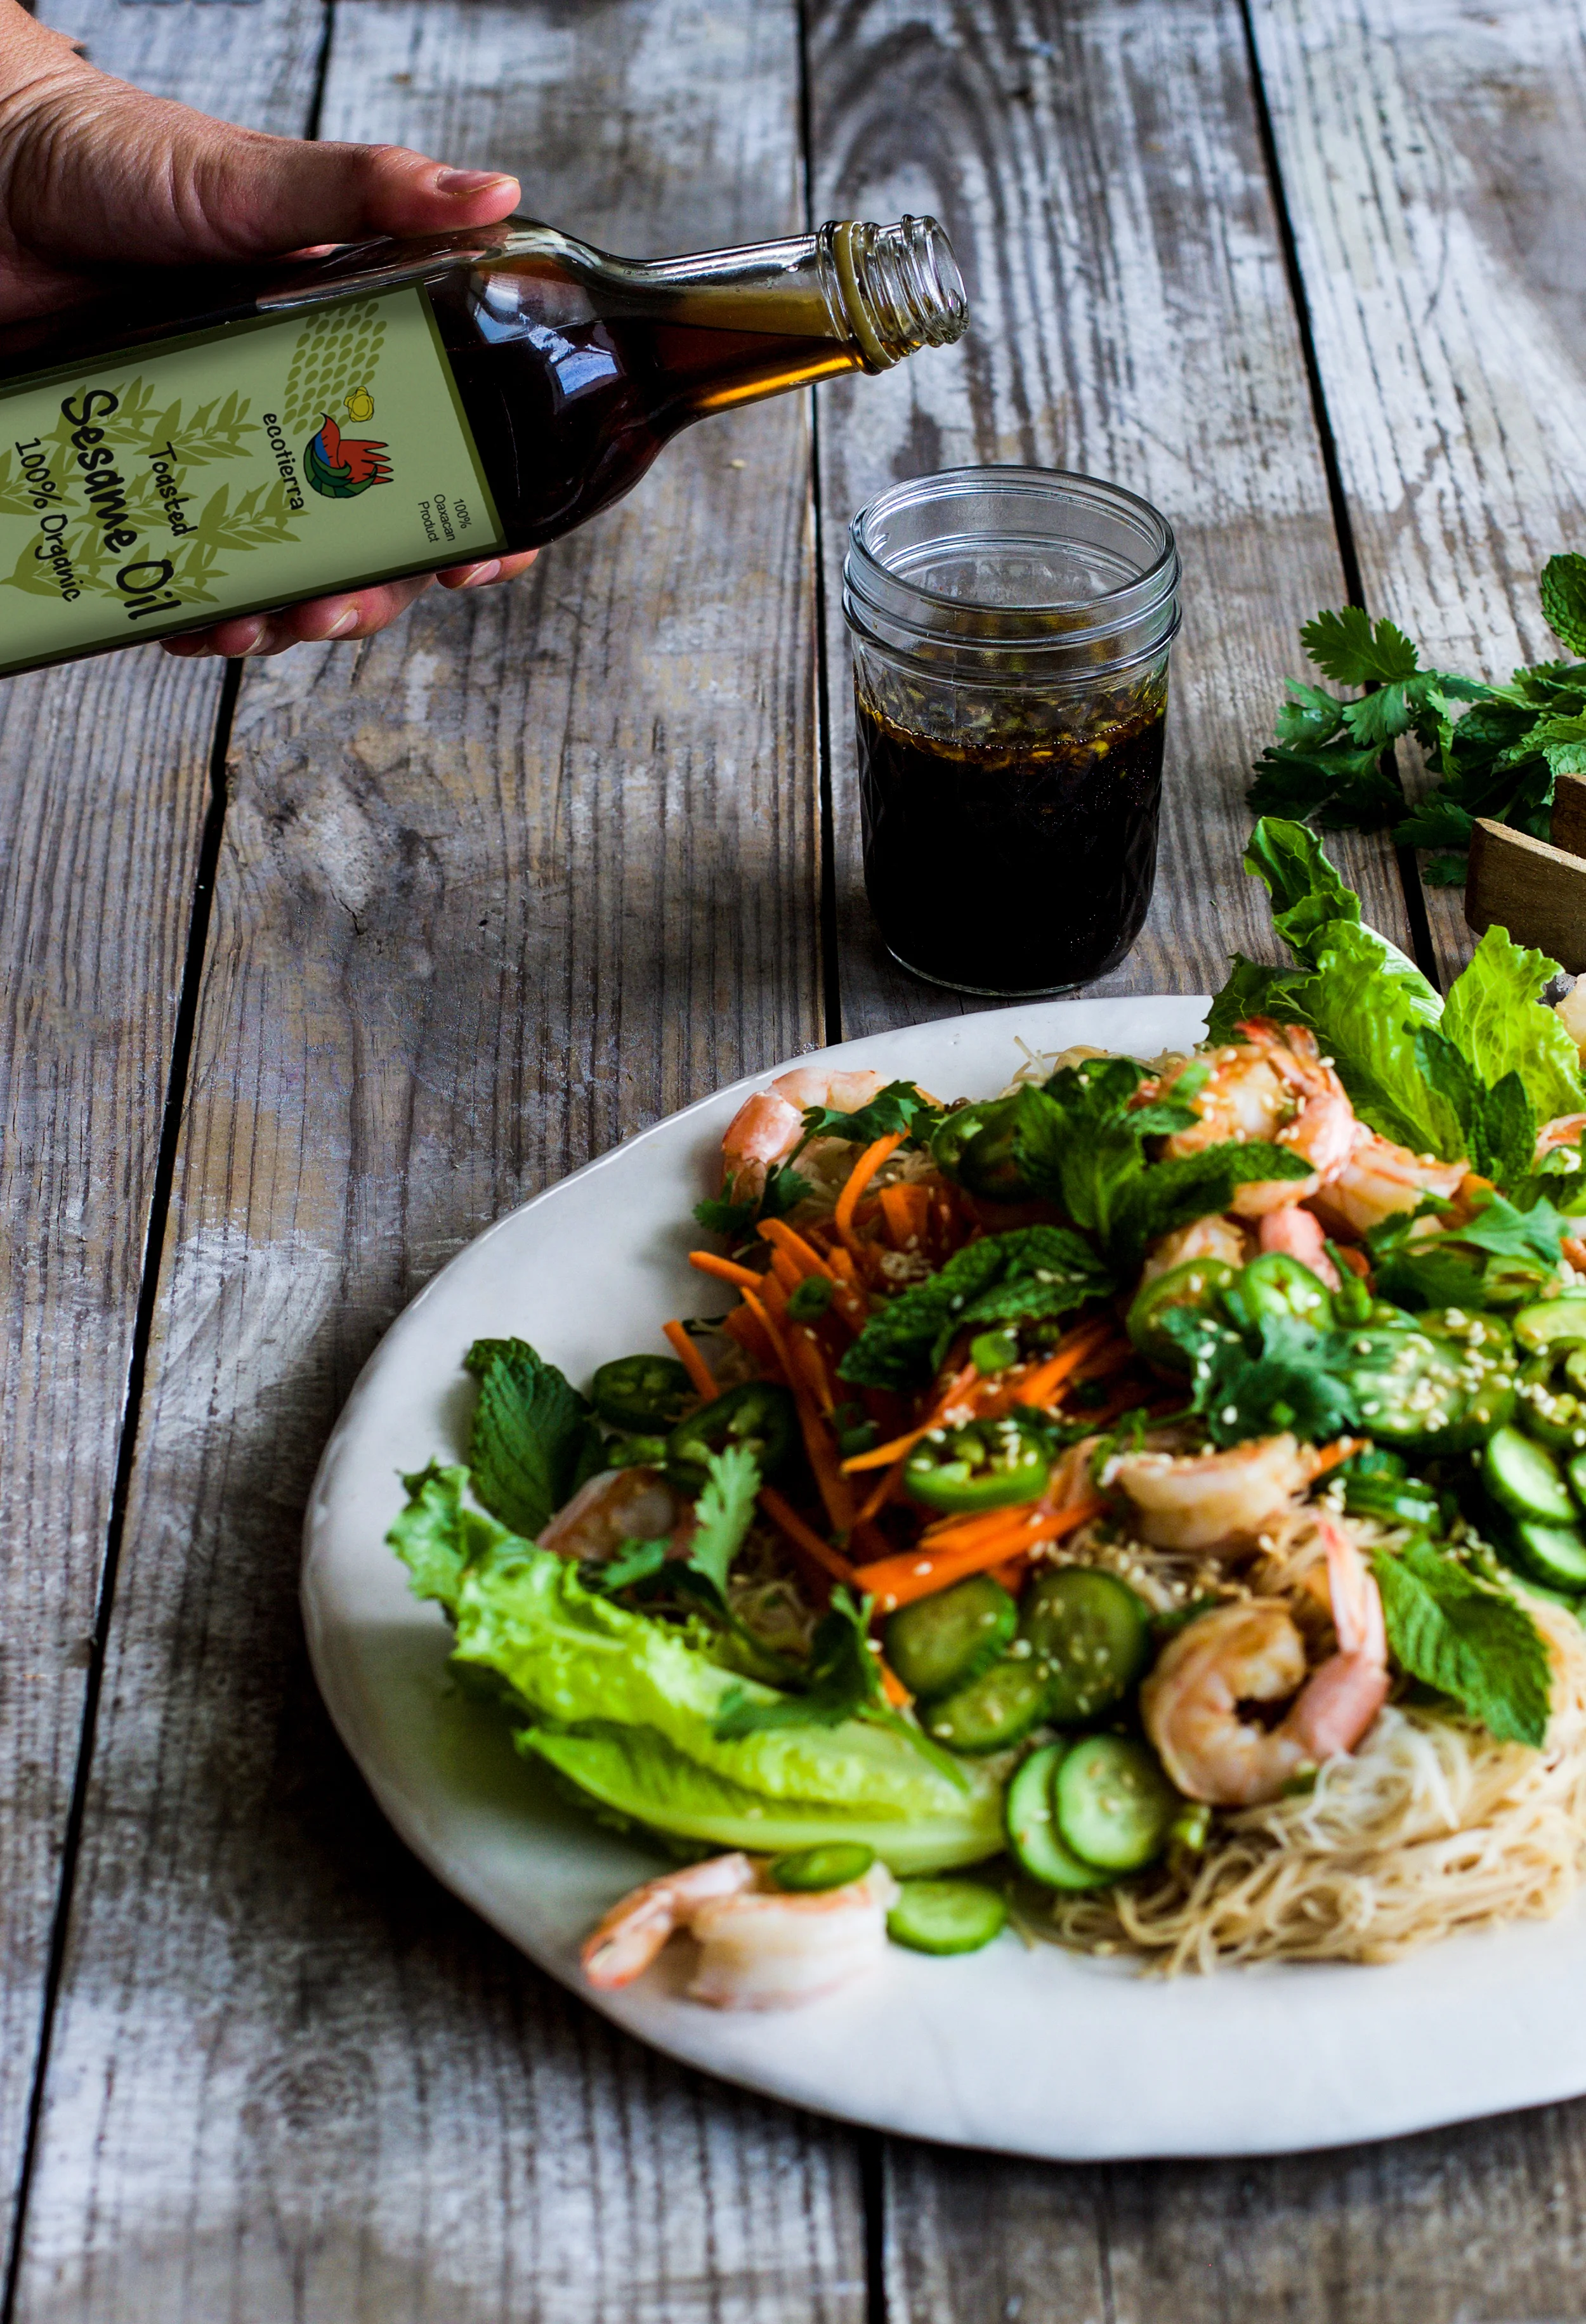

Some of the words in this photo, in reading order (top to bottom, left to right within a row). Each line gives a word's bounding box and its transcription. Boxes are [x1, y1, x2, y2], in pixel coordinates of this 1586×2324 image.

[15, 437, 63, 509] 100%
[148, 441, 199, 537] Toasted
[263, 412, 305, 511] ecotierra
[60, 389, 138, 554] Sesame
[115, 558, 182, 621] Oil
[417, 500, 440, 543] Product
[434, 494, 455, 542] Oaxacan
[453, 499, 472, 529] 100%
[34, 514, 81, 603] Organic
